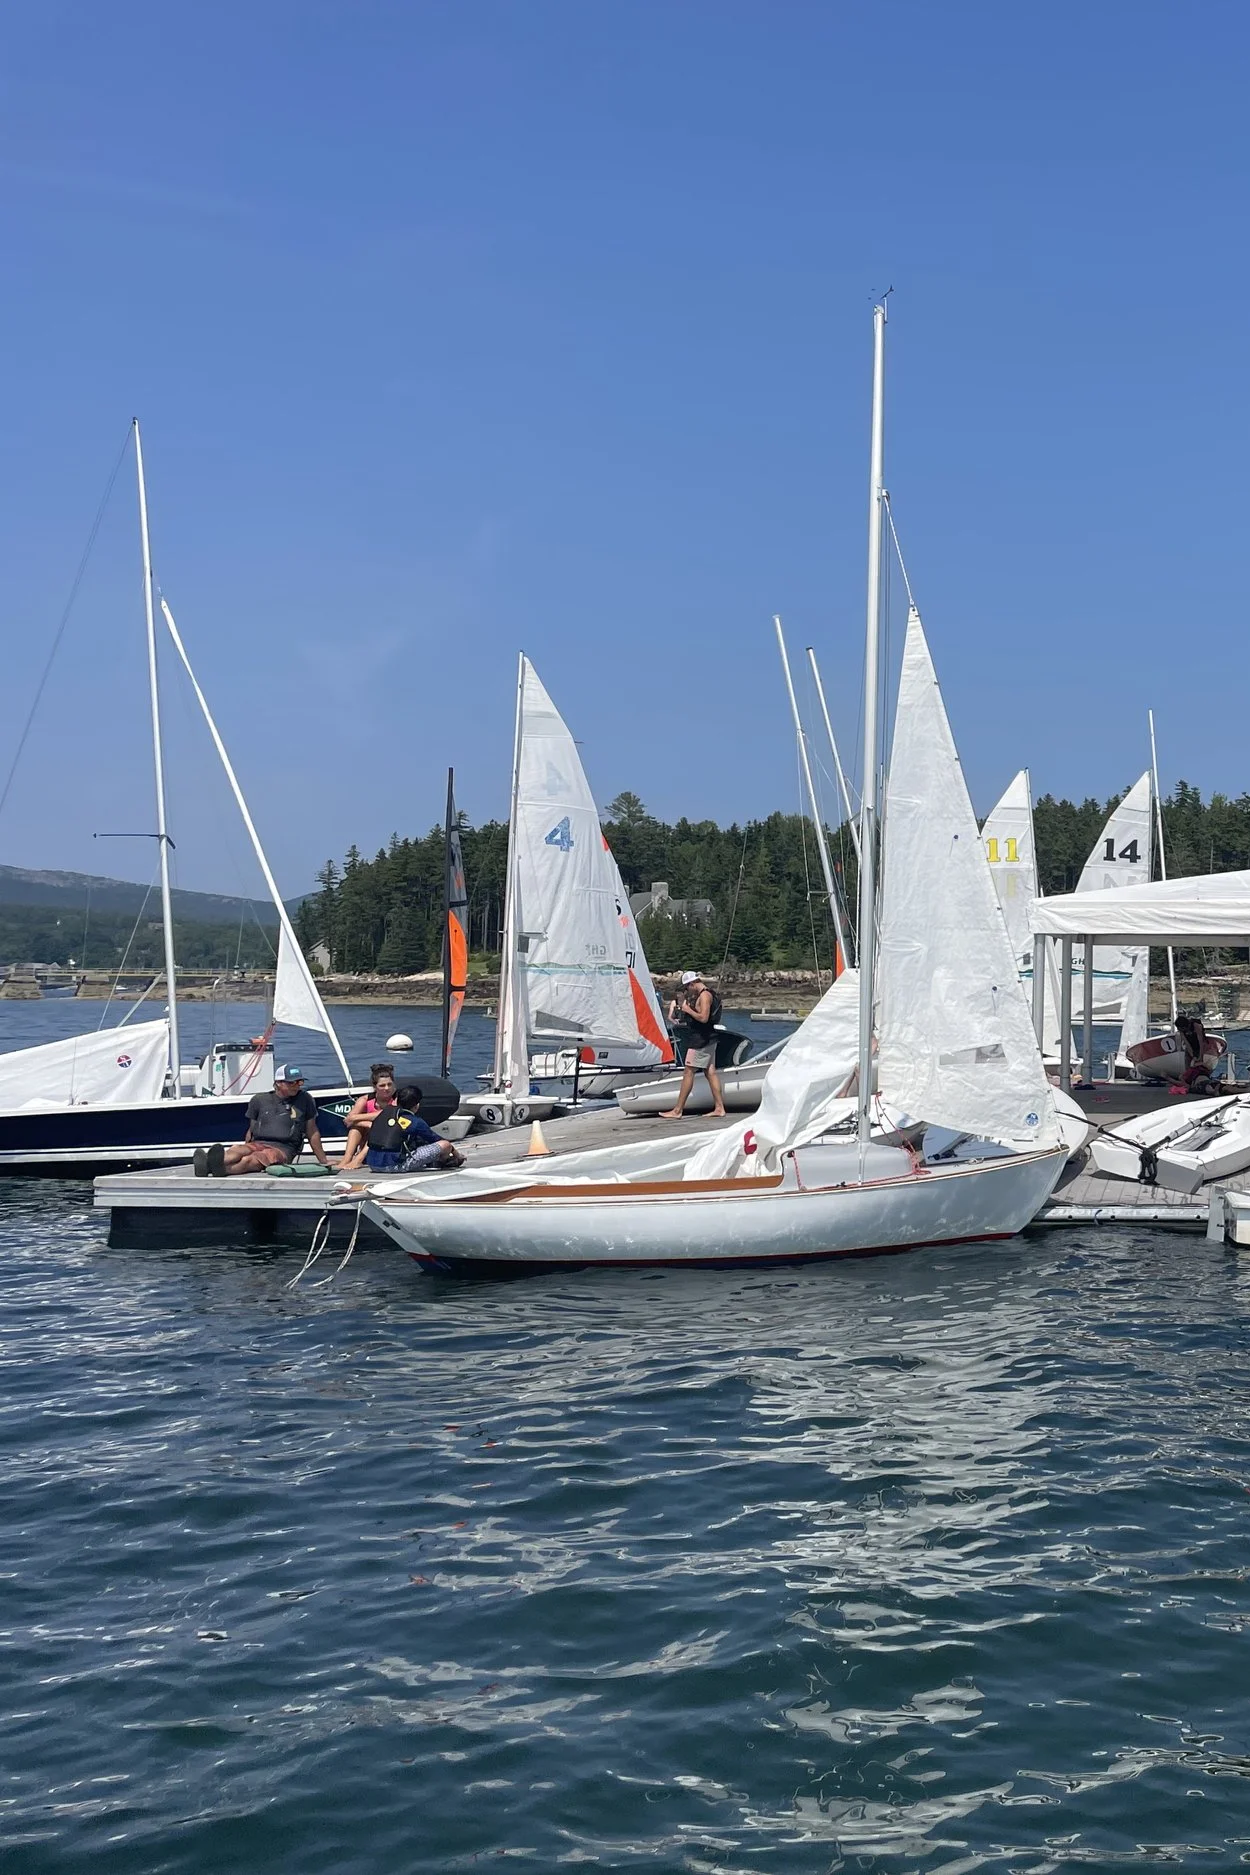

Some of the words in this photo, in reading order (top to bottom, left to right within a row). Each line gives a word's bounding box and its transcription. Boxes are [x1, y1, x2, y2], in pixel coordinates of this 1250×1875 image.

[544, 815, 575, 852] 4
[985, 838, 1021, 862] 11
[1103, 838, 1142, 863] 14
[486, 1108, 496, 1121] 8
